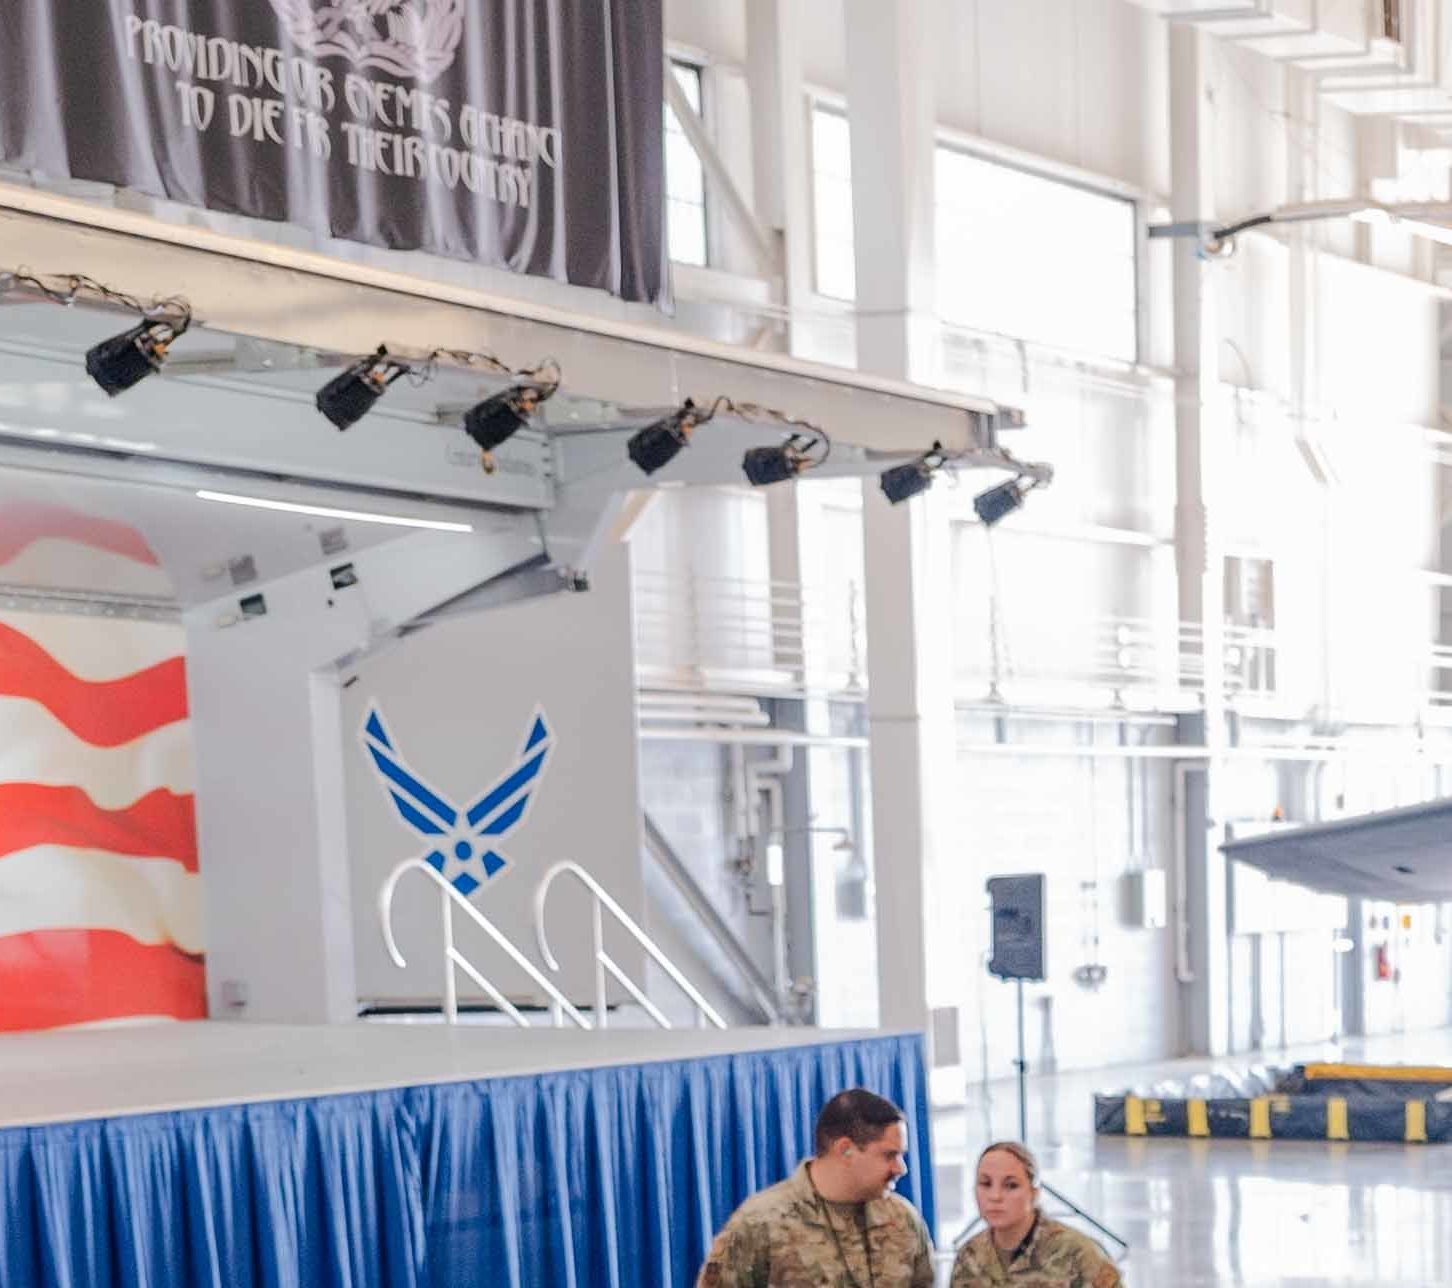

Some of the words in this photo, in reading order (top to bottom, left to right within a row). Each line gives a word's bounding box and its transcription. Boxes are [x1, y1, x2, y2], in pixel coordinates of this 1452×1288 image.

[124, 15, 285, 95] PROVIDING
[290, 56, 336, 113] OR
[175, 80, 215, 131] TO
[227, 94, 285, 146] DIE
[291, 105, 332, 162] FR
